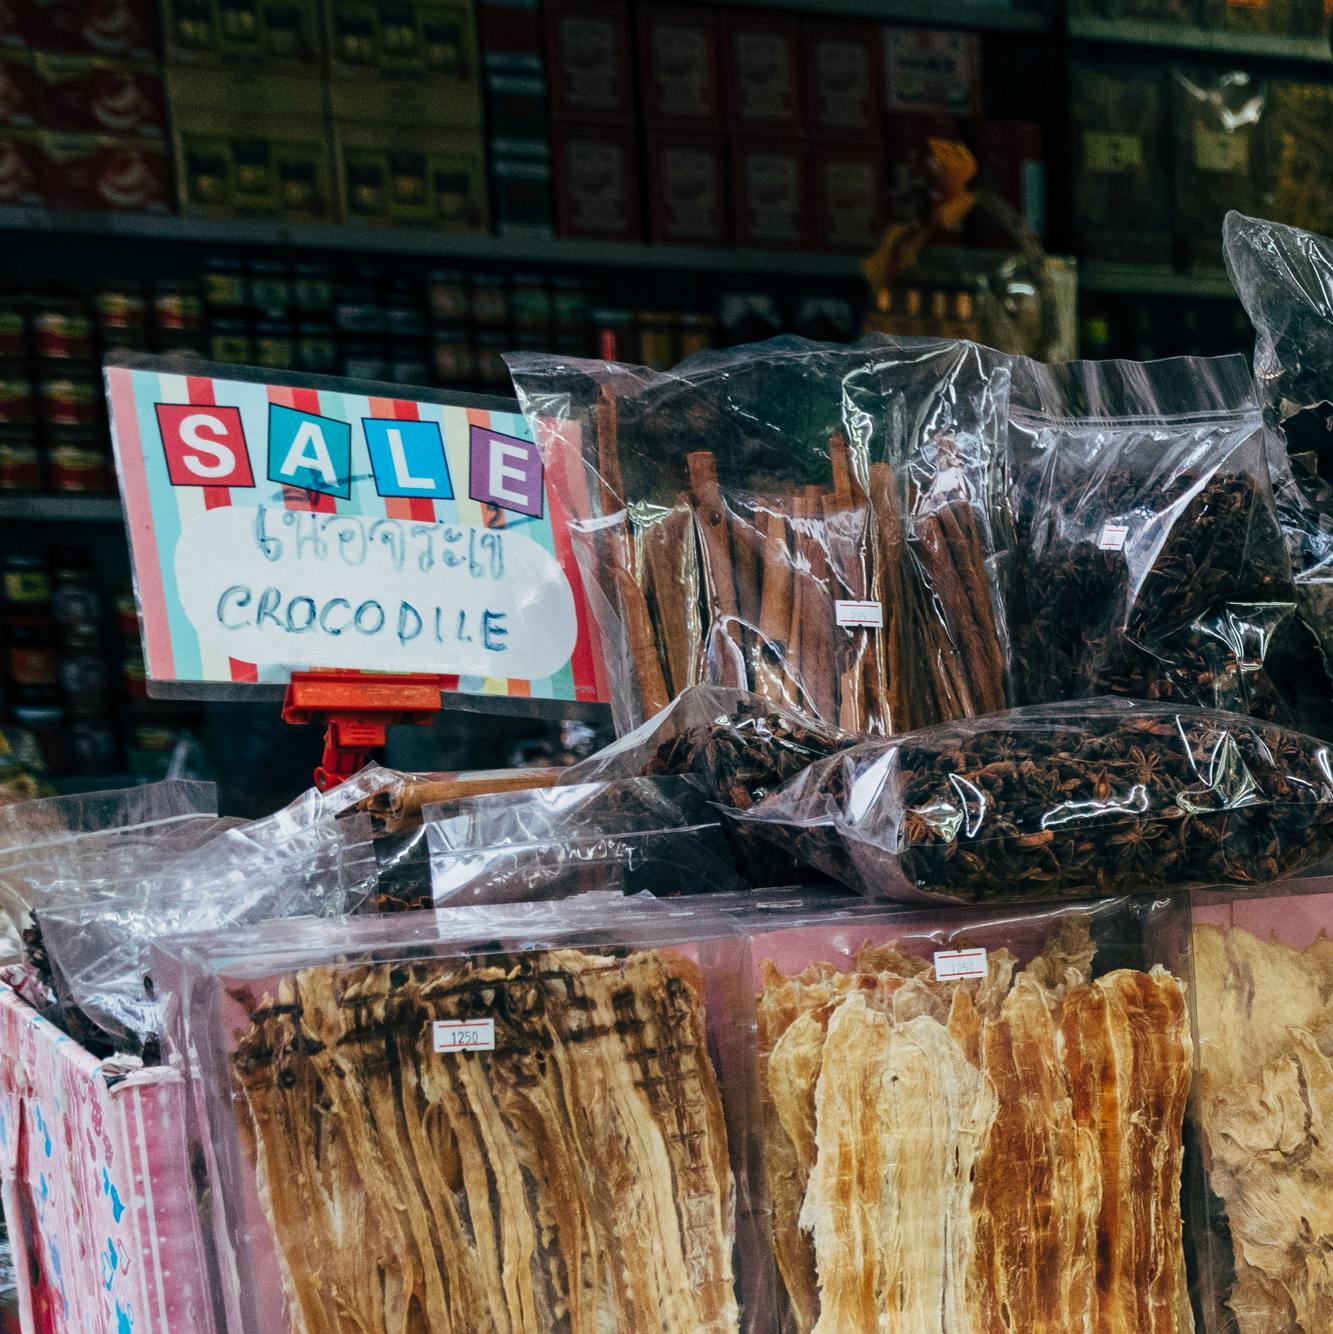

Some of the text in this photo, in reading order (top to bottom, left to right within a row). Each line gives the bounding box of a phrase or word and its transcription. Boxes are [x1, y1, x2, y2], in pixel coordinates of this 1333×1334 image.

[178, 413, 530, 507] SALE
[216, 585, 508, 652] CROCODILE
[451, 1031, 479, 1045] 1250
